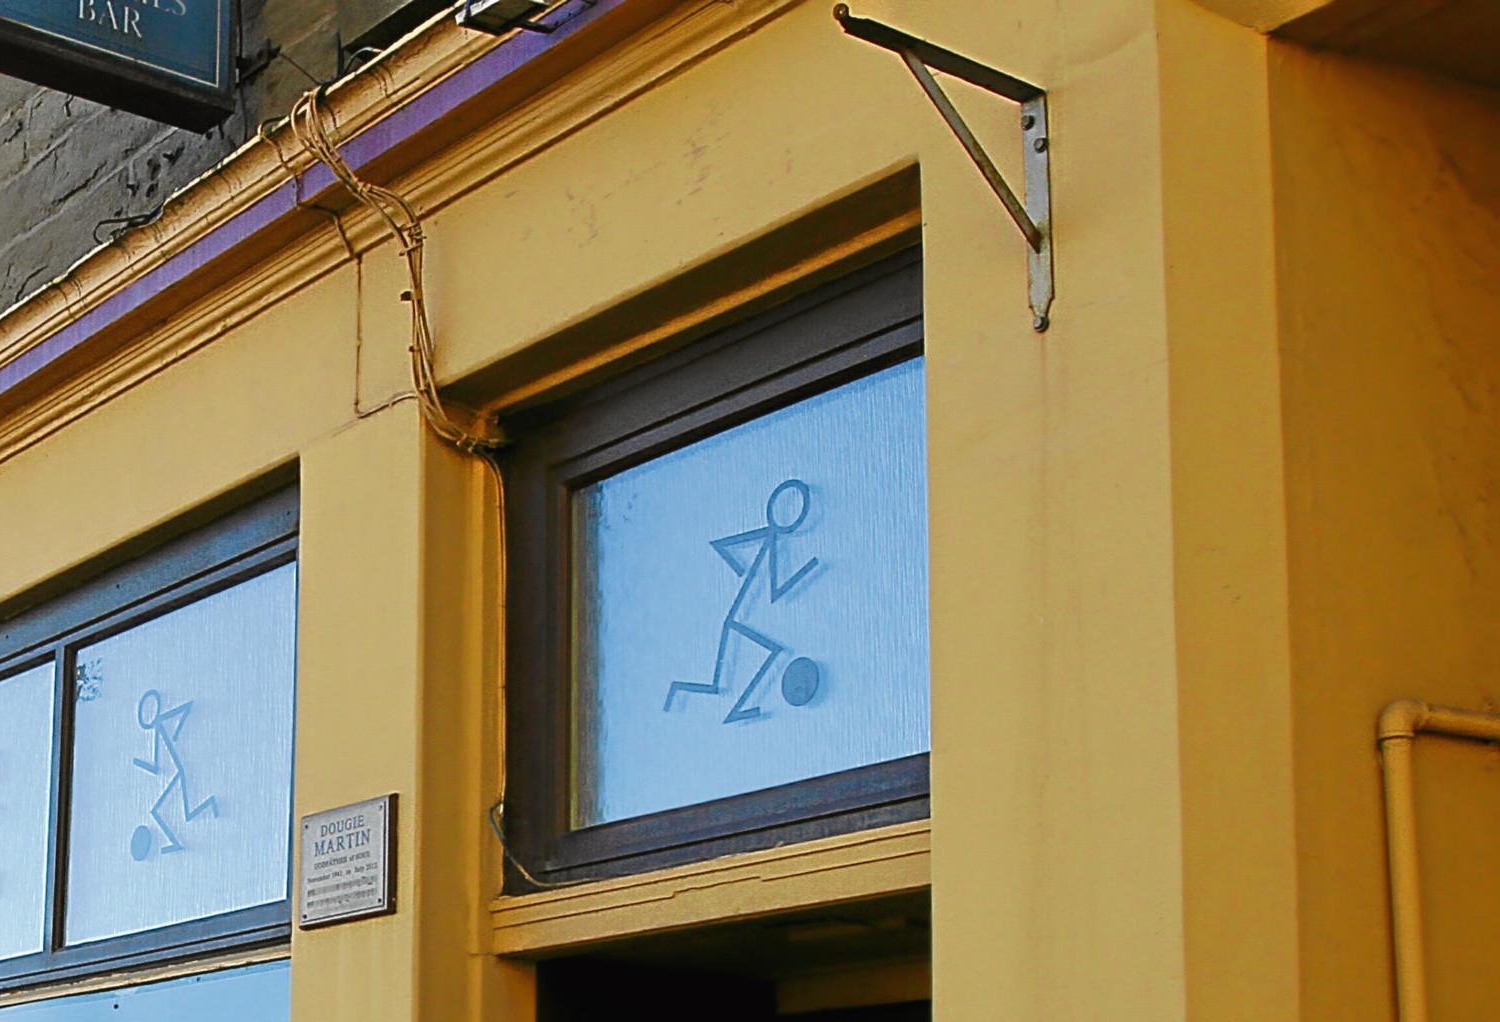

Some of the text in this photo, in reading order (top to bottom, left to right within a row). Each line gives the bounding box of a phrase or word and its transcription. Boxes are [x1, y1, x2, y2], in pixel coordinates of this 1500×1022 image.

[78, 0, 143, 38] BAR
[320, 815, 365, 838] DOUGIE
[314, 828, 371, 857] MARTIN
